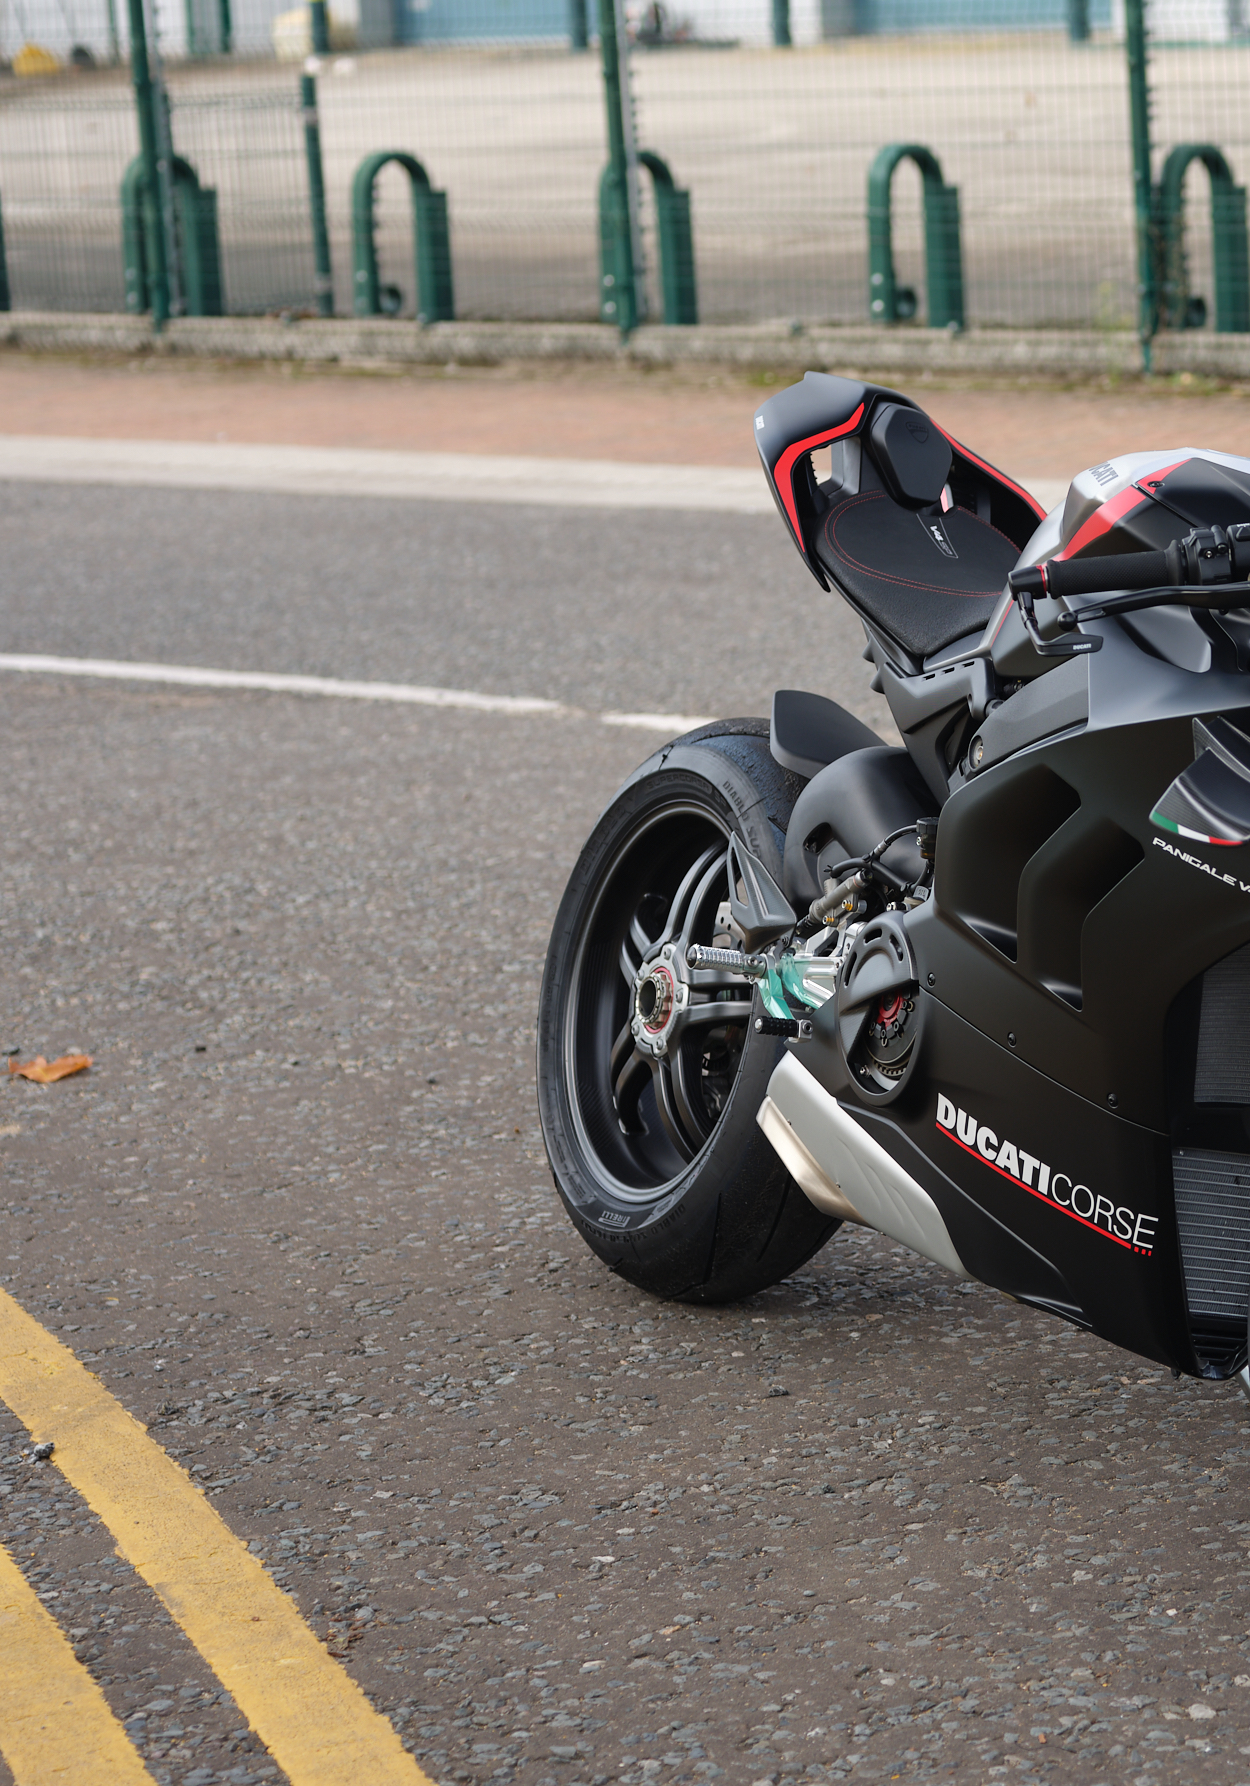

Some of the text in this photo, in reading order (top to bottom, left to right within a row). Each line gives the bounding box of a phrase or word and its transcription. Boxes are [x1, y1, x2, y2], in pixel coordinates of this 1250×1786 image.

[722, 781, 751, 823] DIABLO
[1152, 837, 1237, 887] PANIGALE
[598, 1211, 631, 1228] PIRELLI
